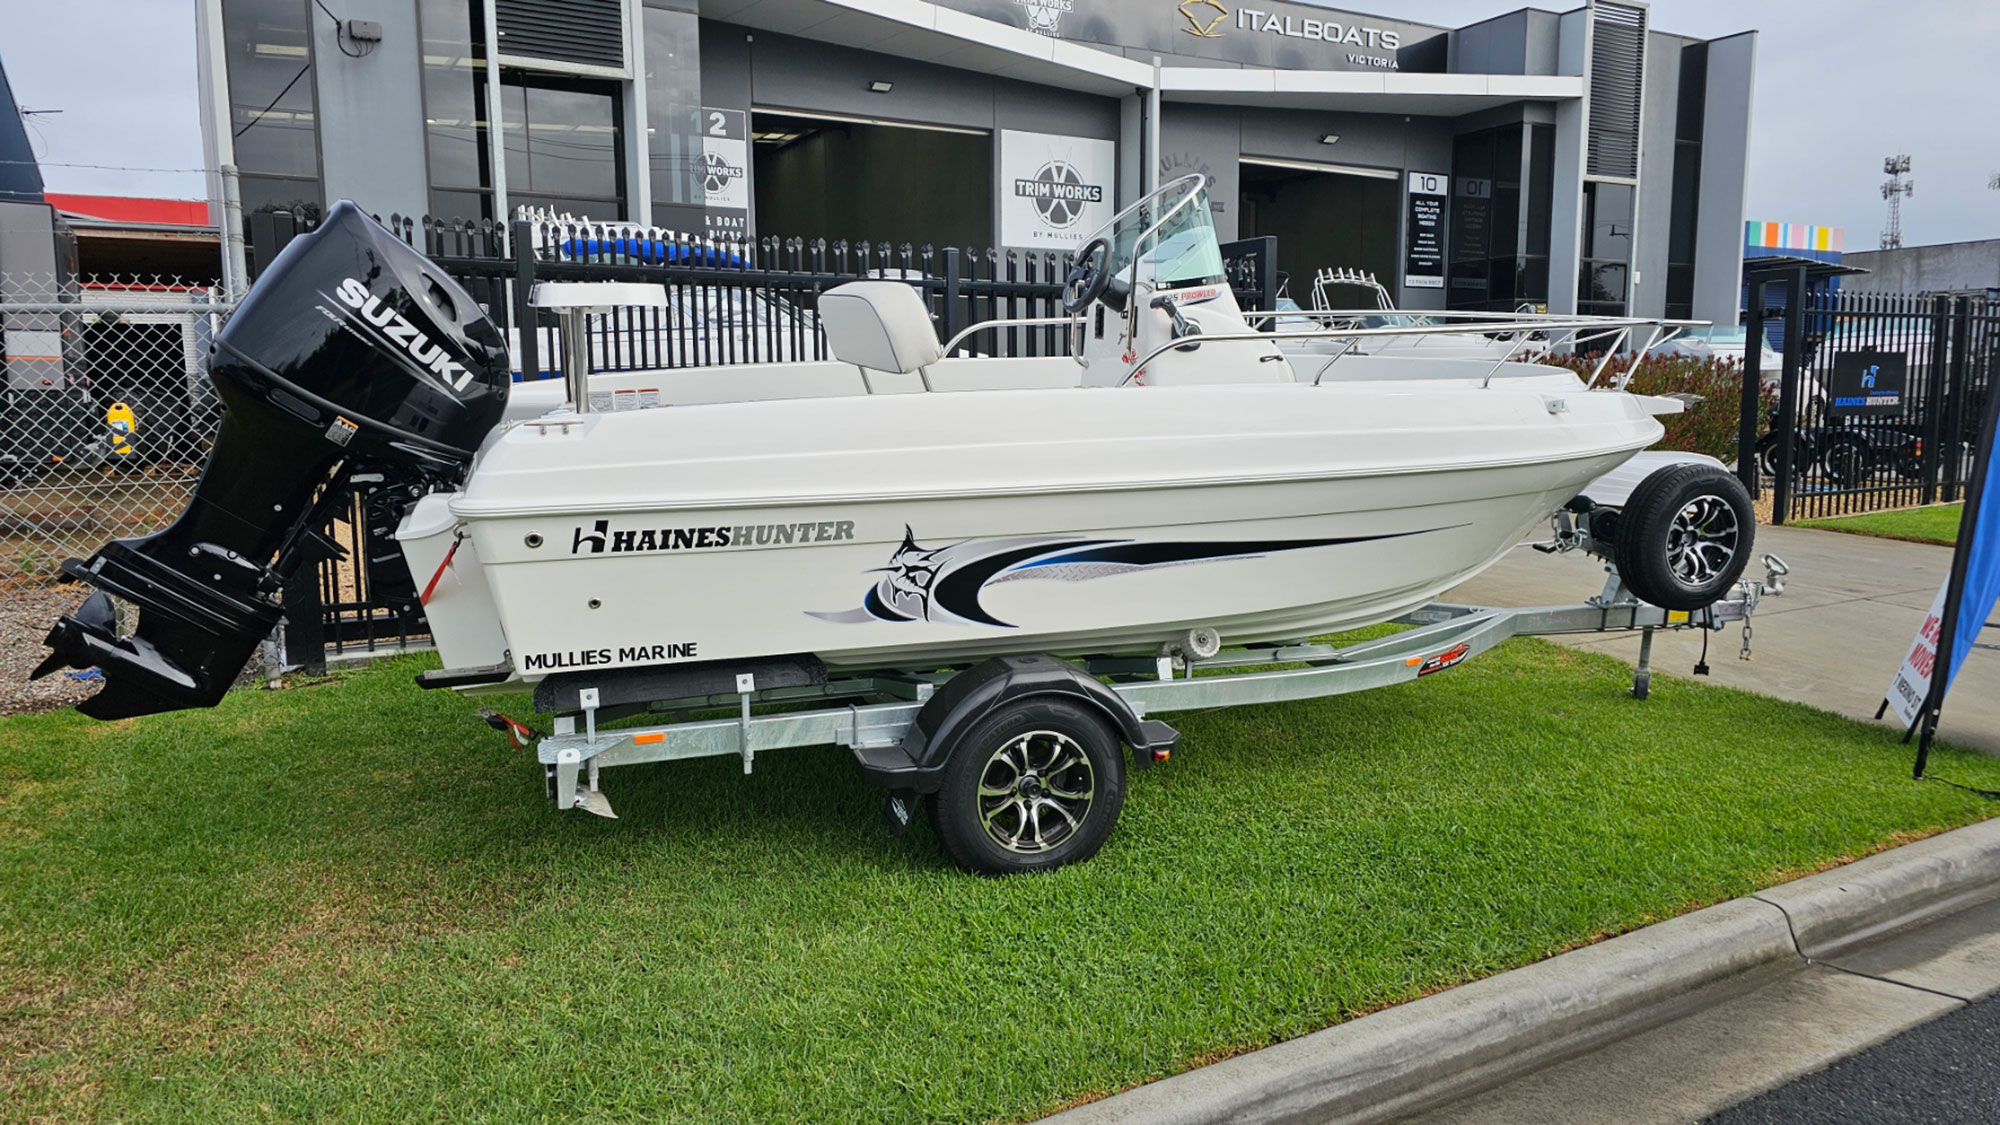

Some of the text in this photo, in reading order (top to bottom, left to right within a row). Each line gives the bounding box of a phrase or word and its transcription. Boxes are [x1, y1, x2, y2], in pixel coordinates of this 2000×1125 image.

[1237, 8, 1400, 50] ITALBOATS
[1346, 53, 1399, 69] VICTORIA
[707, 165, 742, 177] WORKS
[1016, 180, 1101, 201] TRIM WORKS
[1421, 176, 1436, 191] 10
[717, 216, 744, 227] BOAT
[1047, 232, 1083, 240] MULLIES
[336, 278, 474, 393] SUZUKI
[524, 642, 698, 670] MULLIES MARINE
